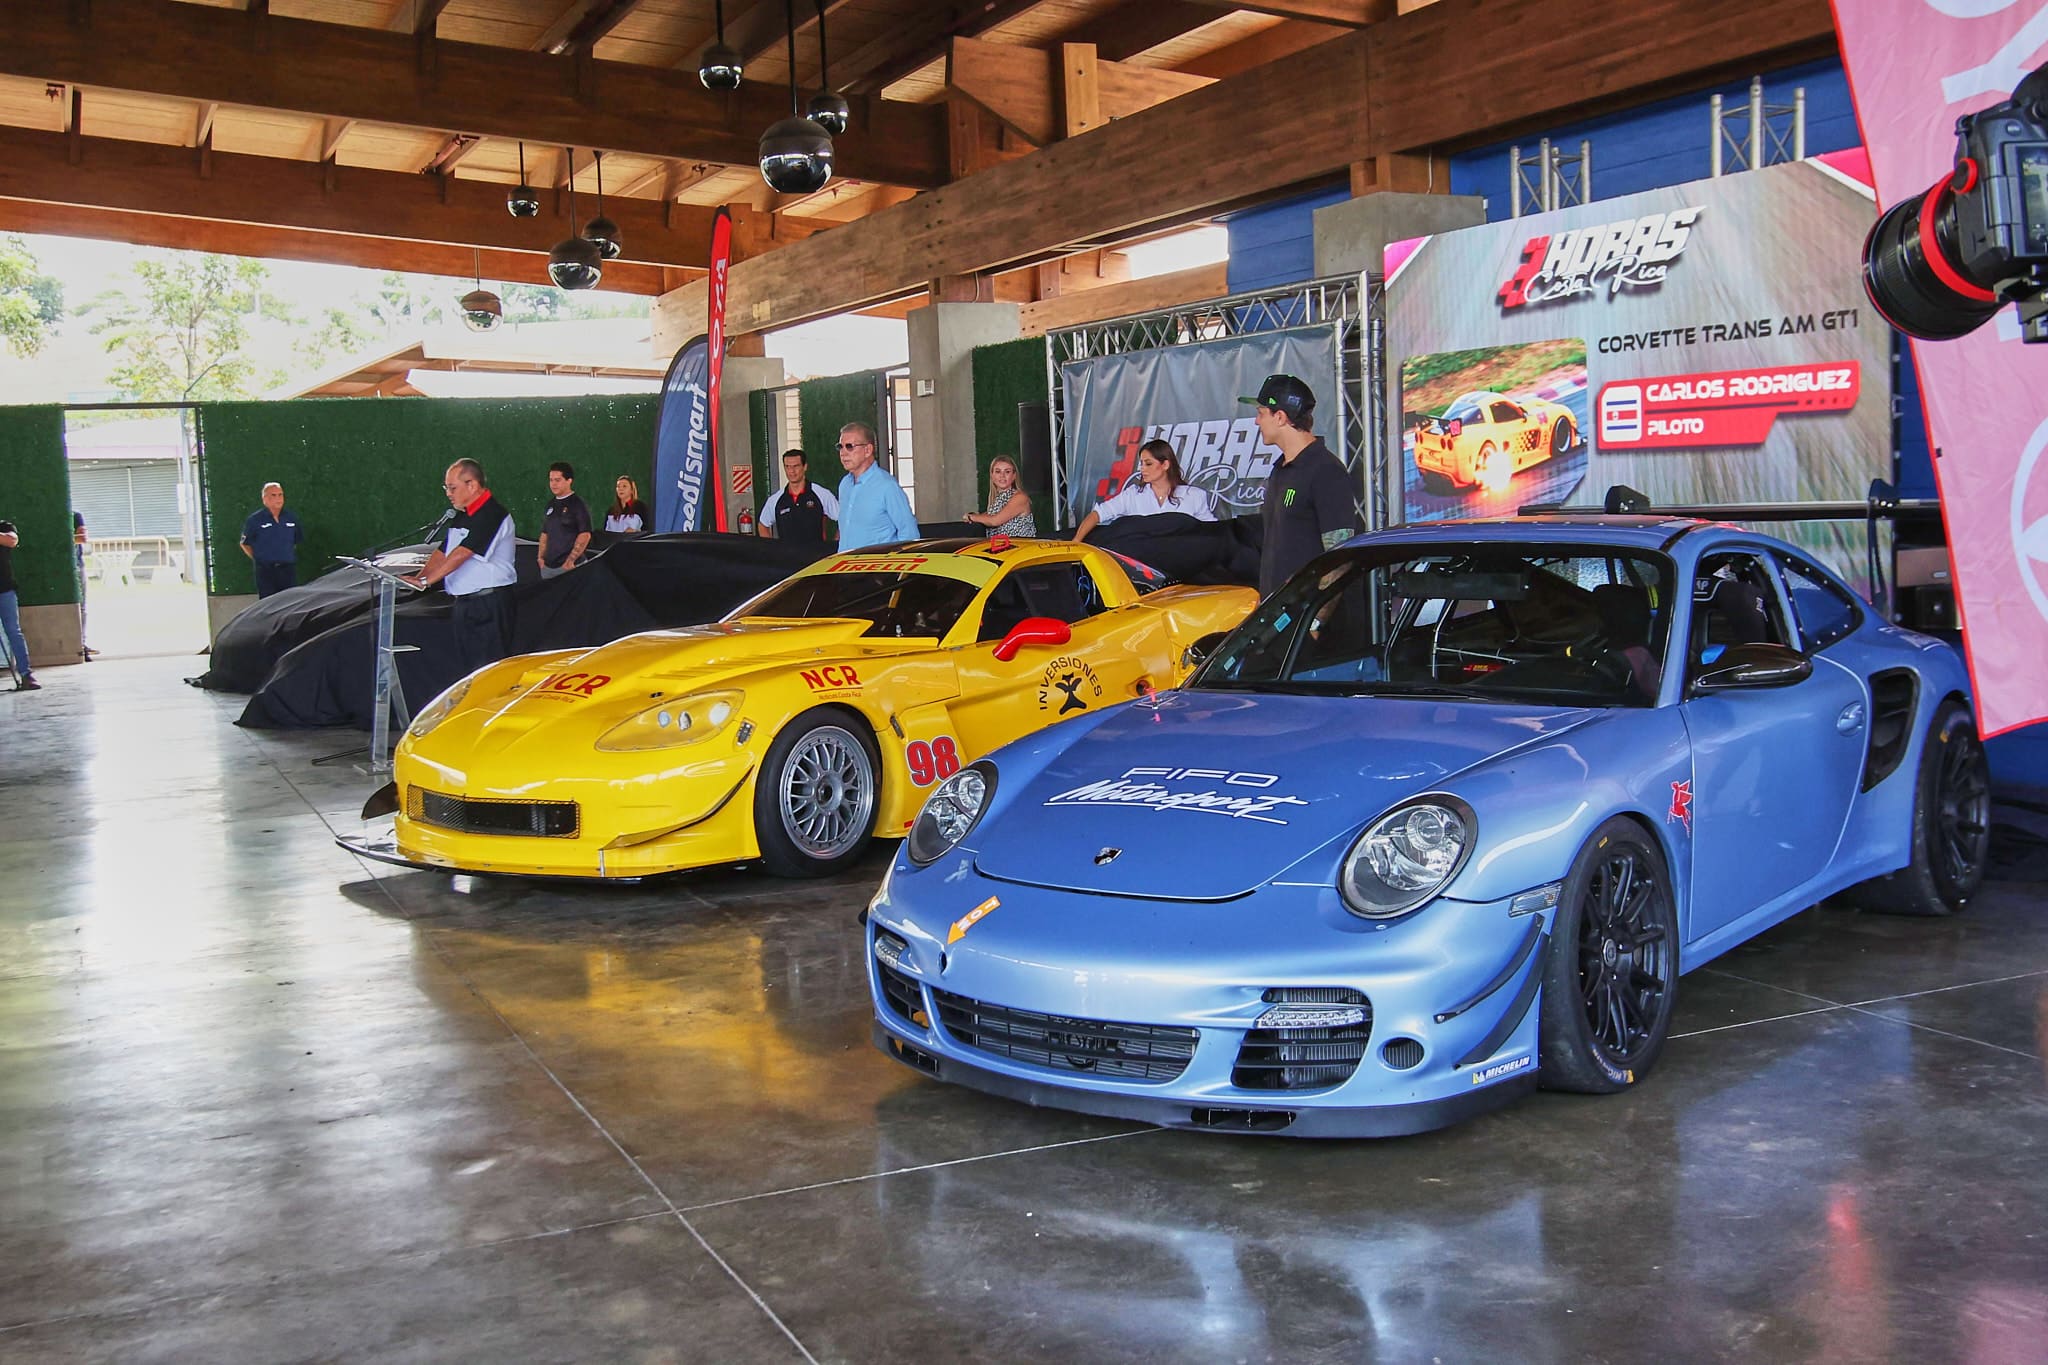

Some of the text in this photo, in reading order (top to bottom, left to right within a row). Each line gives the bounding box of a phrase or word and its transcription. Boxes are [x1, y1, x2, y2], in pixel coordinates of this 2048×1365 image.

[1542, 206, 1707, 276] HORAS
[1524, 254, 1668, 302] Costa Rica
[1598, 308, 1859, 354] CORVETTE TRANS AM GT1
[1646, 368, 1852, 402] CARLOS RODRIGUEZ
[1646, 417, 1705, 436] PILOTO
[827, 557, 929, 573] PIRELLI
[800, 665, 863, 690] NCR
[1039, 656, 1103, 711] INVERSIONES
[905, 735, 962, 788] 98
[1120, 767, 1280, 788] FIFO
[1049, 778, 1309, 818] Motorsport
[957, 898, 997, 932] TOW
[1485, 1055, 1530, 1080] MICHELIN
